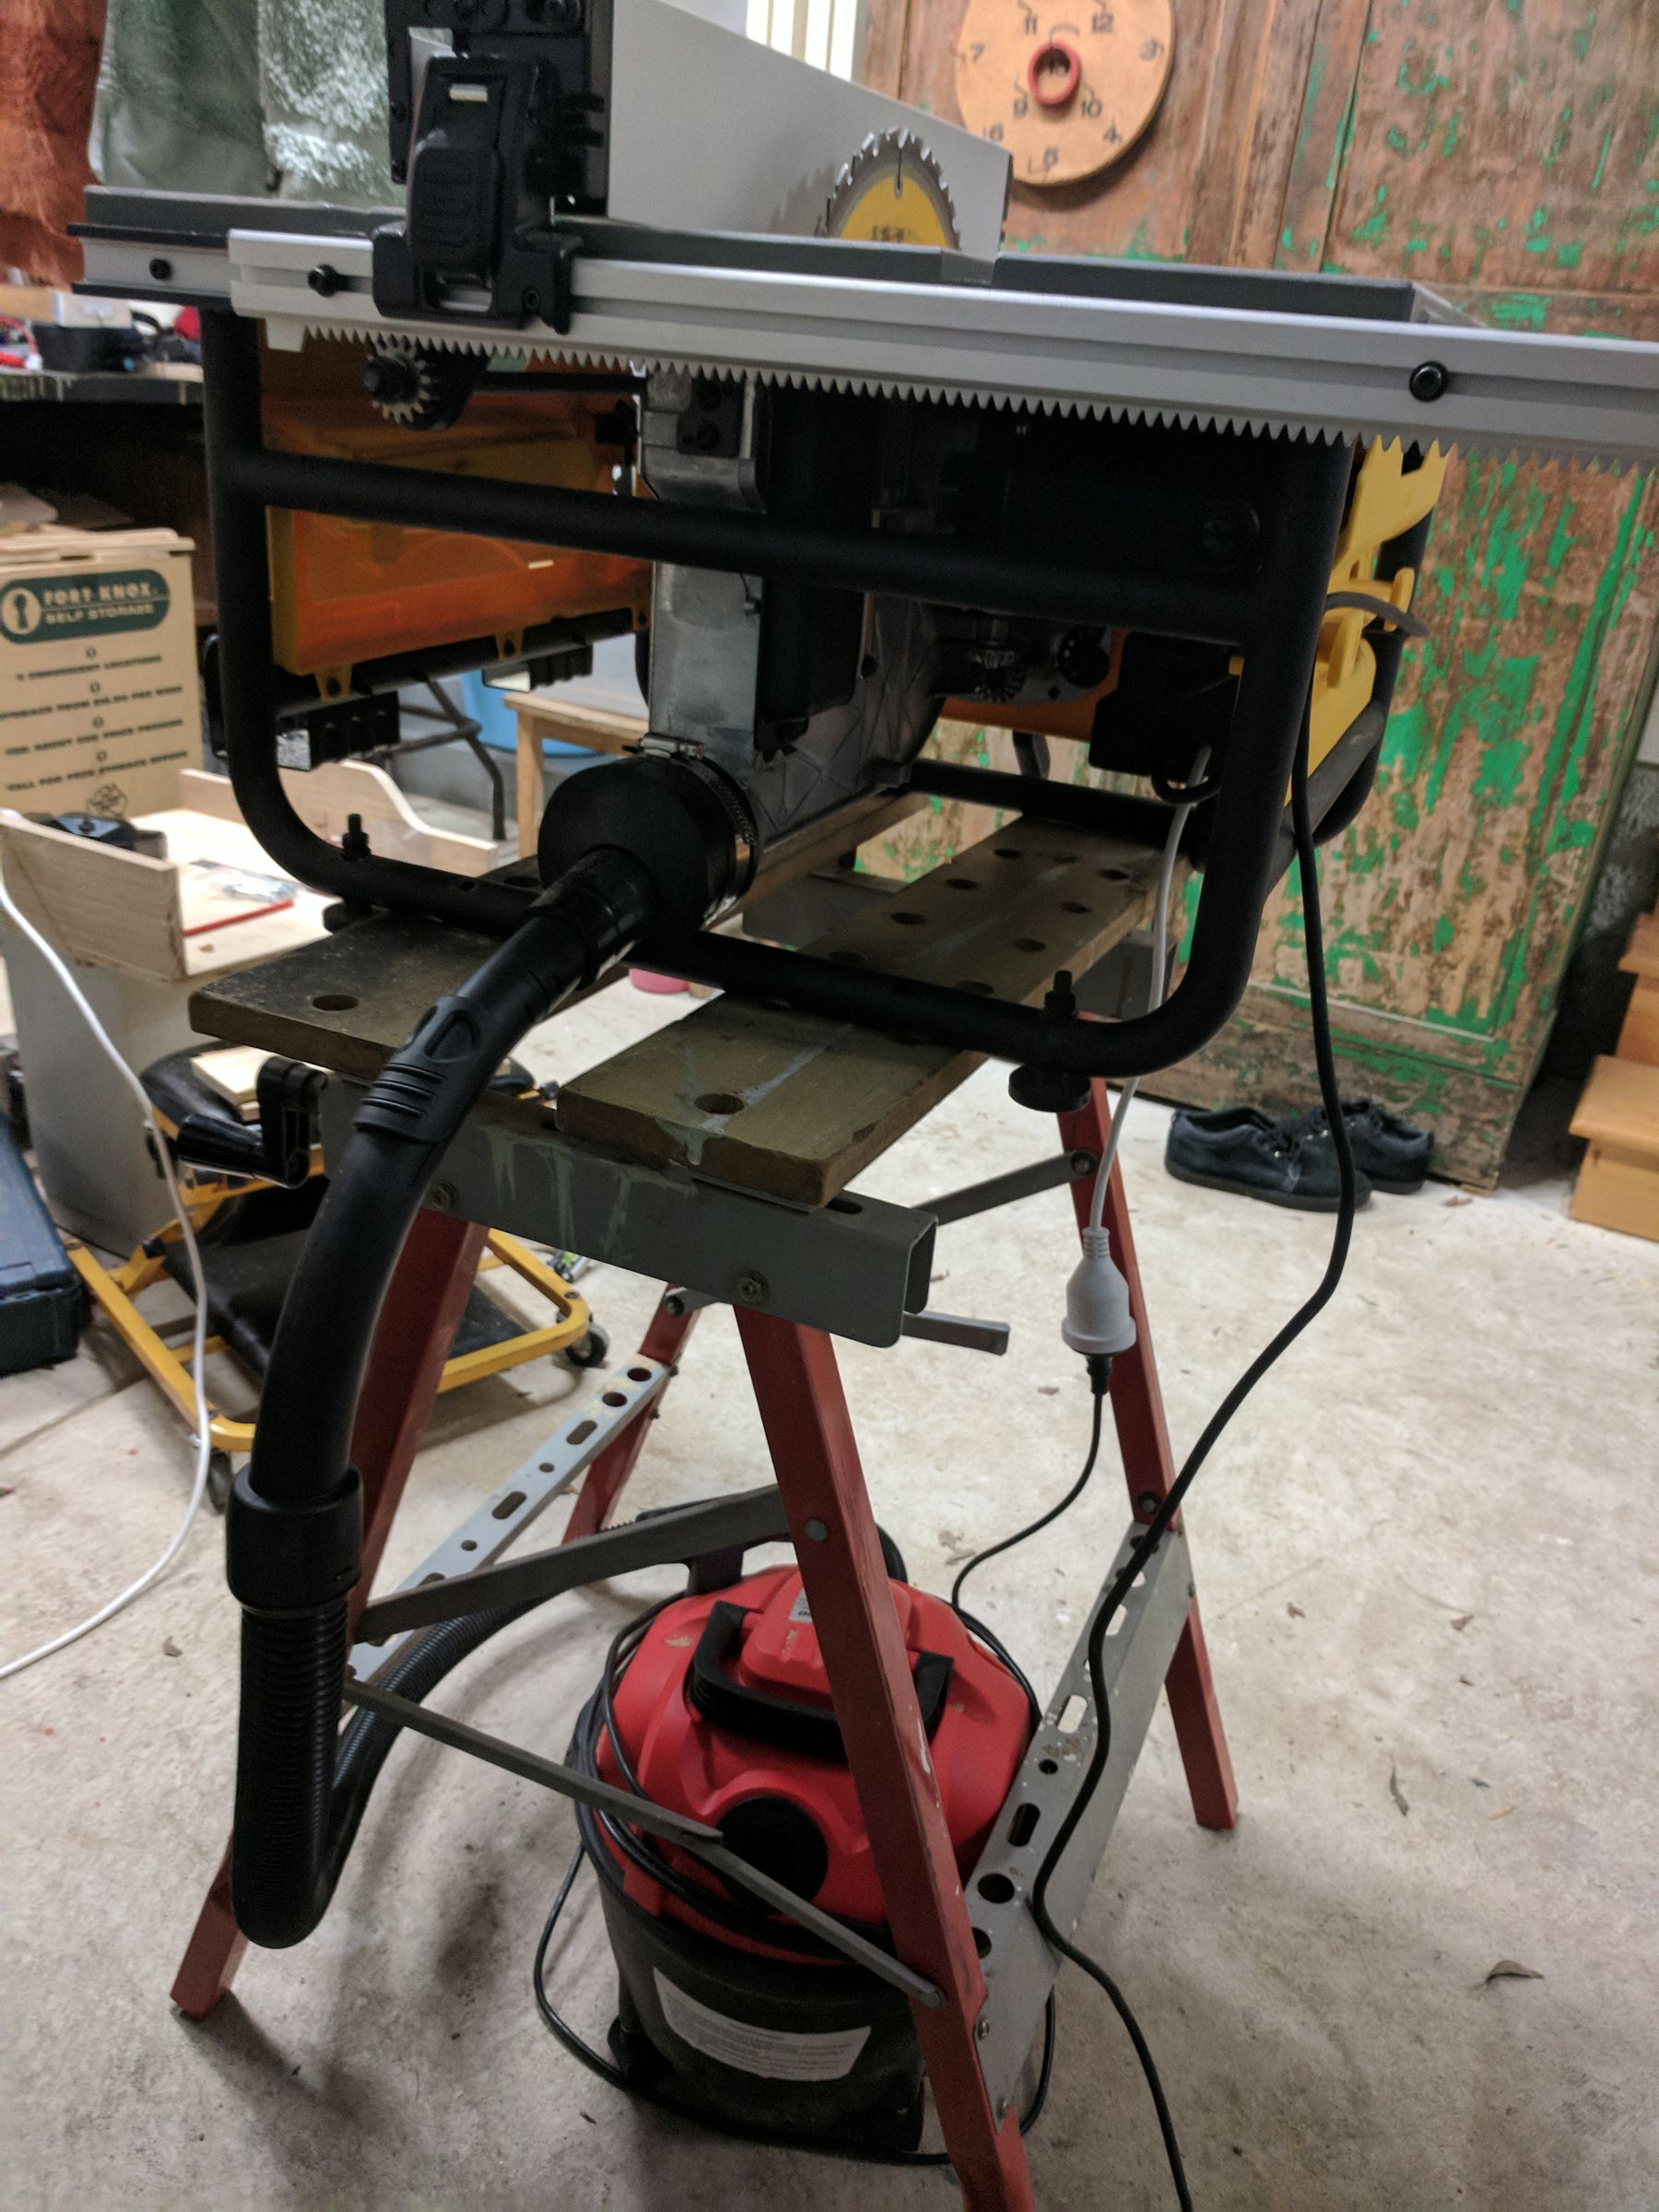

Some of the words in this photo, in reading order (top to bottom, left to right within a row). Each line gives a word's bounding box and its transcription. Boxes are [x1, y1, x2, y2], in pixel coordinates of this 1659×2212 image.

[1091, 13, 1113, 34] 12
[1081, 99, 1102, 118] 10
[43, 588, 91, 606] FORT
[99, 582, 150, 602] KNOX
[45, 610, 84, 624] SELF
